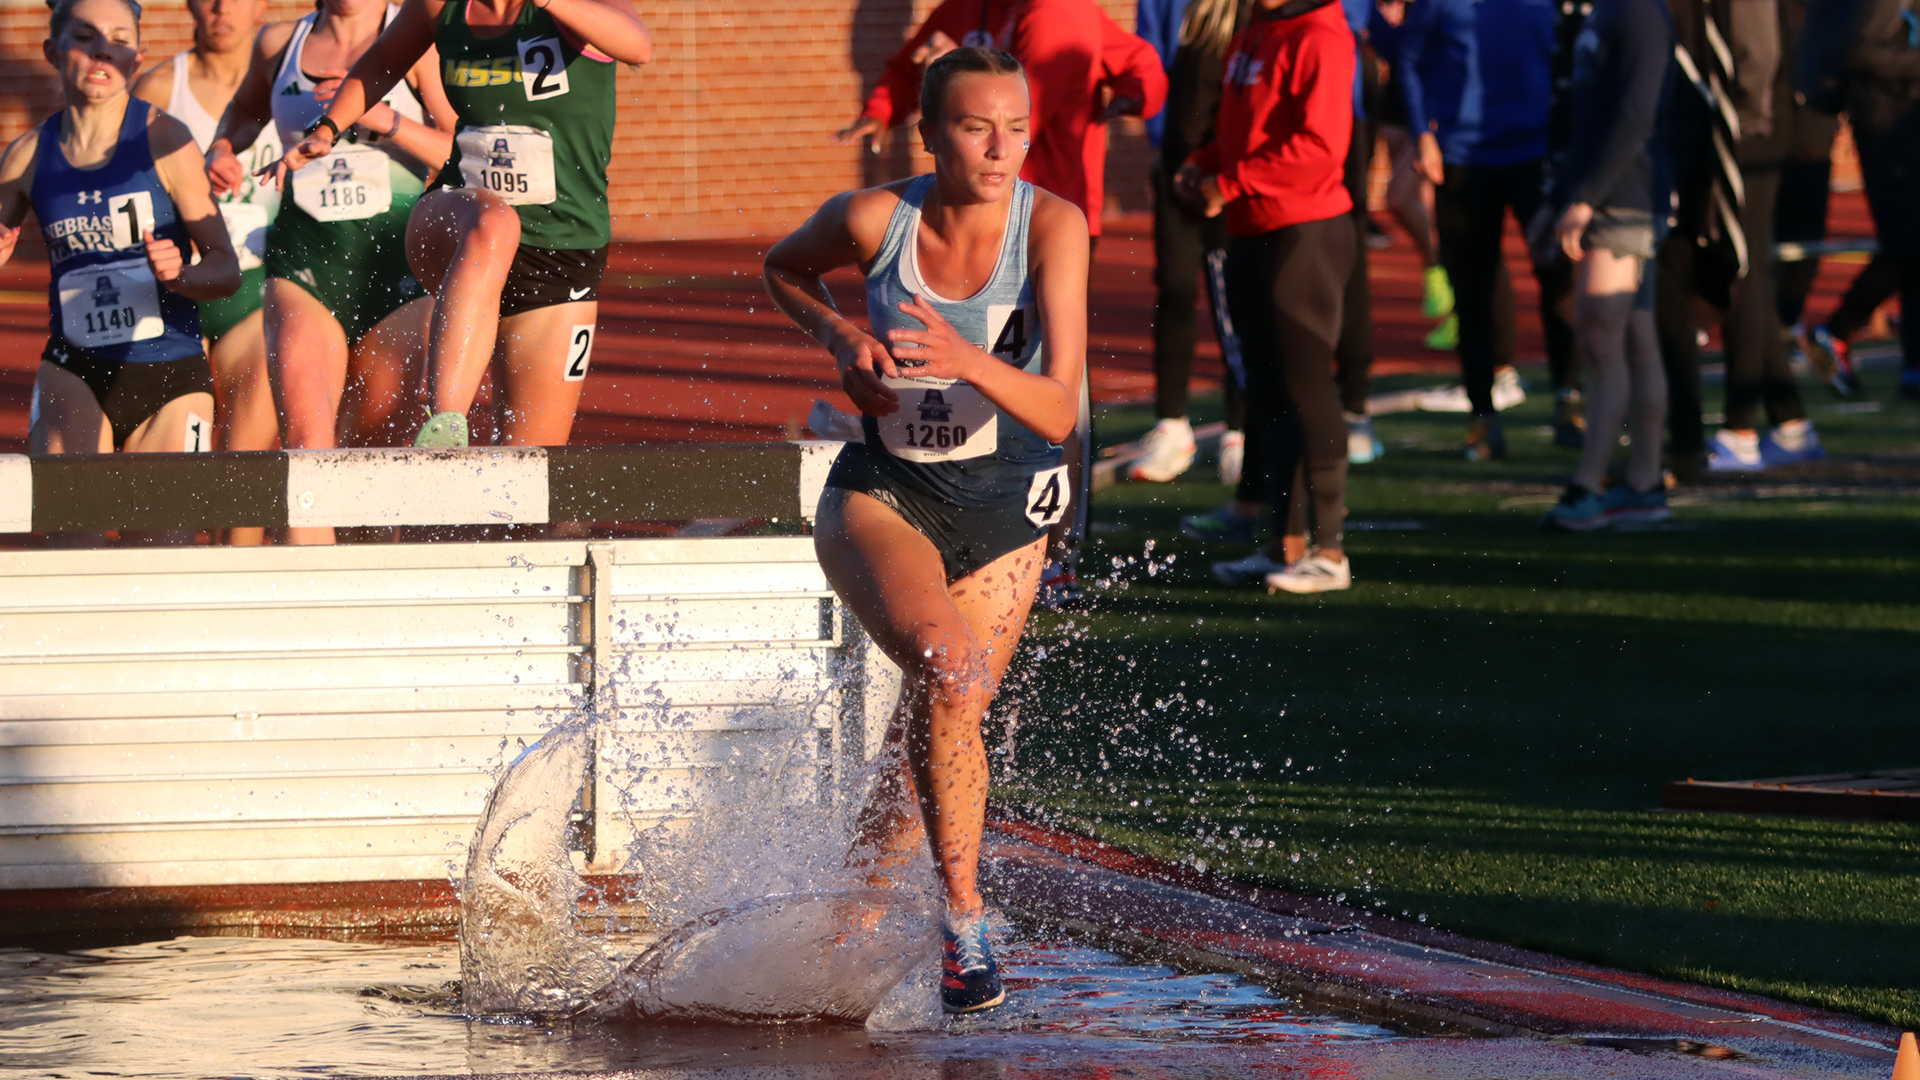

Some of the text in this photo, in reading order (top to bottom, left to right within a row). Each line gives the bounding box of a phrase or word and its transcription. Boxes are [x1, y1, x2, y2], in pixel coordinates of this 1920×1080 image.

[524, 45, 561, 96] 2
[320, 186, 366, 207] 1186
[481, 169, 528, 193] 1095
[117, 198, 139, 244] 1
[85, 306, 136, 334] 1140
[992, 308, 1028, 360] 4
[568, 329, 590, 377] 2
[191, 421, 200, 451] 1
[905, 423, 967, 448] 1260
[1029, 473, 1062, 520] 4
